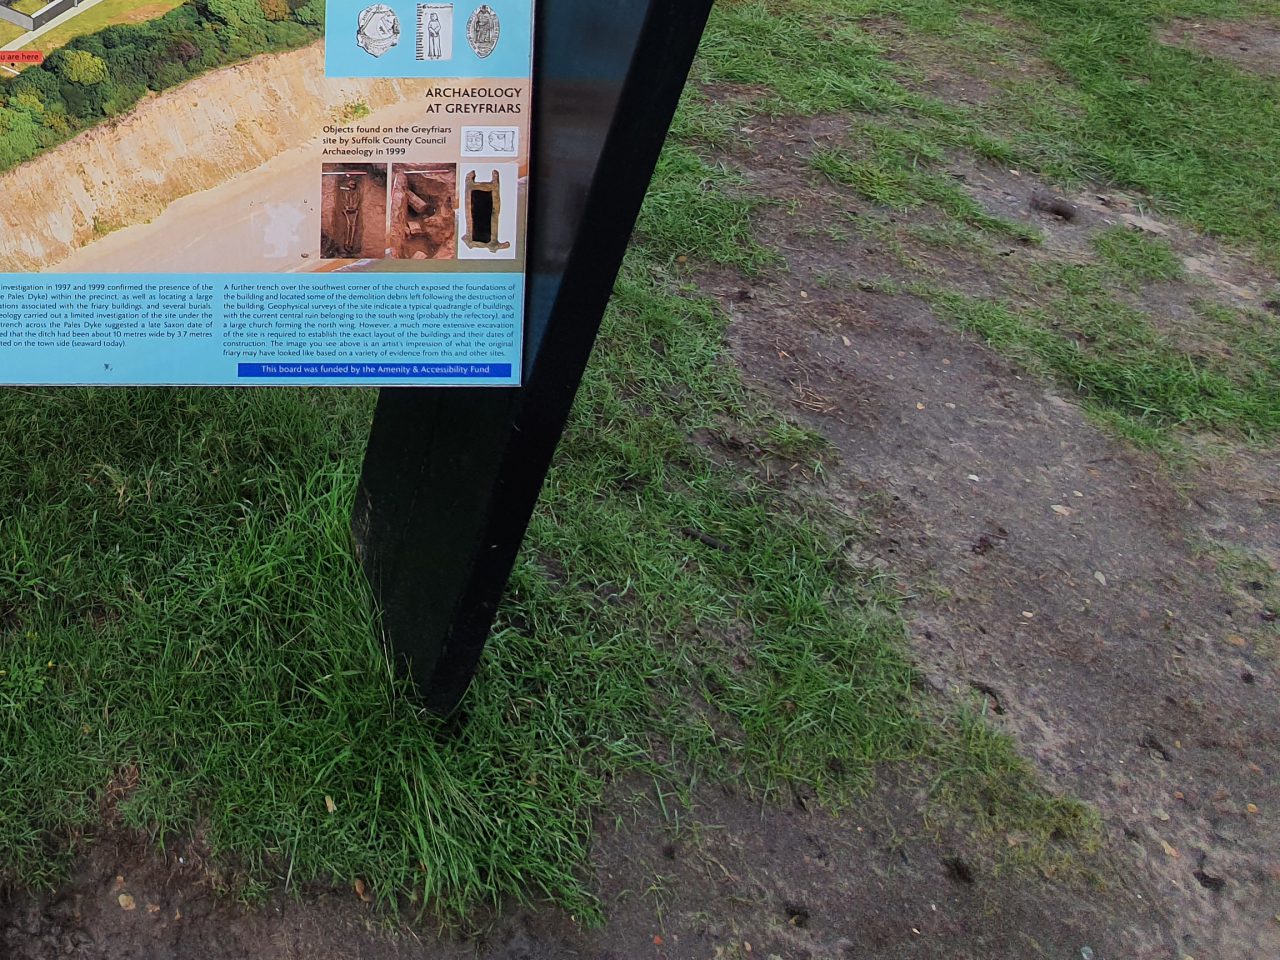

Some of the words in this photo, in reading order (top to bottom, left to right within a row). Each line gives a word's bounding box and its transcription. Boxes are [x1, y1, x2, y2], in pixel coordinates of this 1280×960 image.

[426, 88, 522, 97] ARCHAEOLOGY
[427, 104, 441, 113] AT
[446, 104, 520, 113] GREYFRIARS
[322, 125, 354, 135] Objects
[356, 125, 381, 133] found
[395, 125, 409, 133] the
[411, 126, 452, 135] Greyfriars
[339, 136, 349, 146] by
[351, 136, 380, 144] Suffolk
[382, 136, 413, 146] County
[415, 136, 446, 144] Council
[322, 147, 373, 157] Archaeology
[0, 284, 44, 292] investigation
[145, 283, 157, 291] the
[222, 349, 241, 358] friary
[454, 349, 468, 357] and
[262, 365, 277, 373] This
[278, 365, 302, 373] board
[320, 365, 349, 373] funded
[350, 365, 360, 374] by
[362, 365, 376, 373] the
[378, 366, 411, 374] Amenity
[420, 366, 468, 374] Accessibility
[470, 365, 490, 373] Fund
